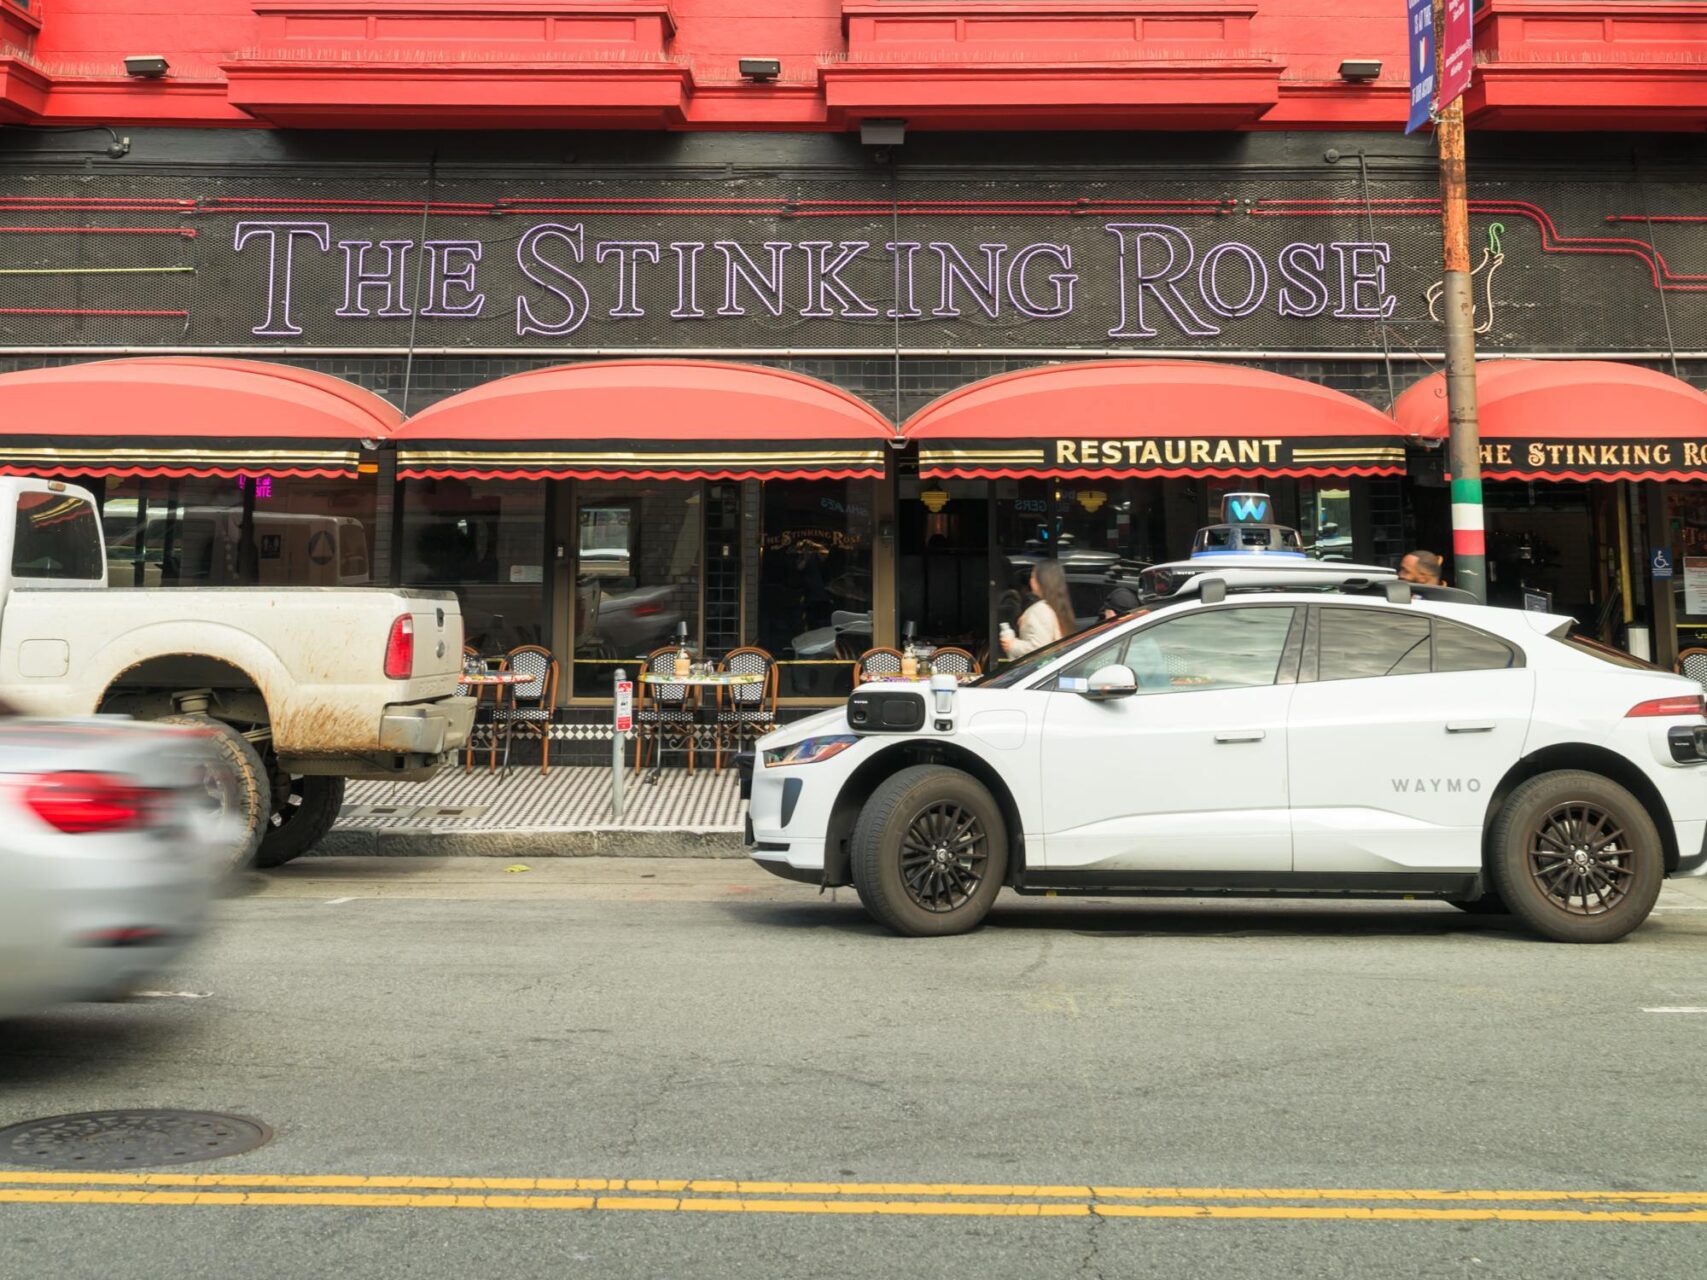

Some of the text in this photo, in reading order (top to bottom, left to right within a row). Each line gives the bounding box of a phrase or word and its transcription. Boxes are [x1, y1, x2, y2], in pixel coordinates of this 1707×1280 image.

[235, 221, 1396, 337] THE STINKING ROSE
[1056, 439, 1282, 465] RESTAURANT
[1479, 444, 1512, 464] HE
[1528, 442, 1671, 467] STINKING
[1392, 778, 1481, 793] WAYMO
